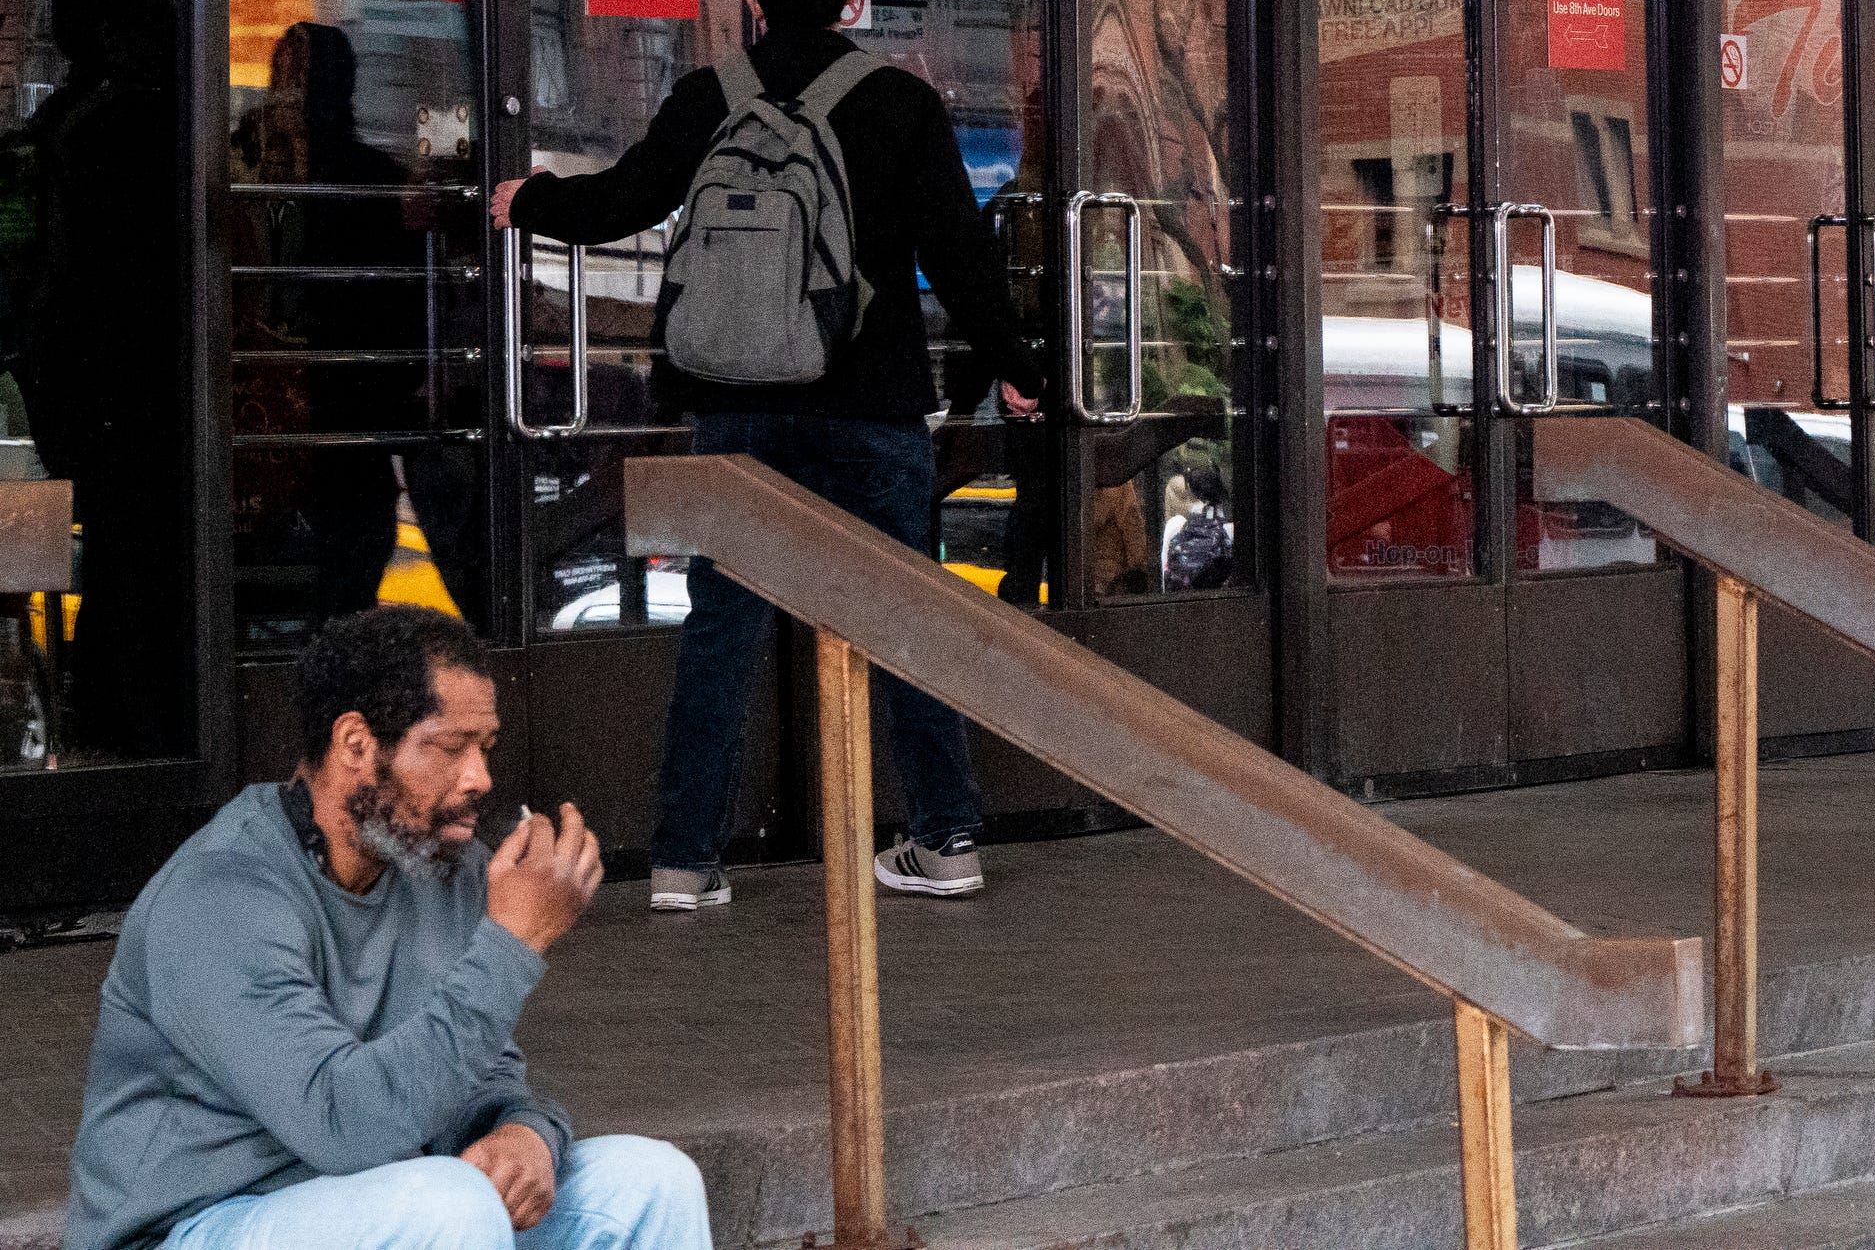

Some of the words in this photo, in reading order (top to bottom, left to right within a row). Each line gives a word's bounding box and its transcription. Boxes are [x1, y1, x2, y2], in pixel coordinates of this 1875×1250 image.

[1552, 0, 1568, 14] Use
[1569, 1, 1583, 15] 8th
[1583, 2, 1597, 16] Ave
[1597, 3, 1621, 18] Doors
[1320, 19, 1377, 41] FREE
[1365, 538, 1457, 566] Hop-on
